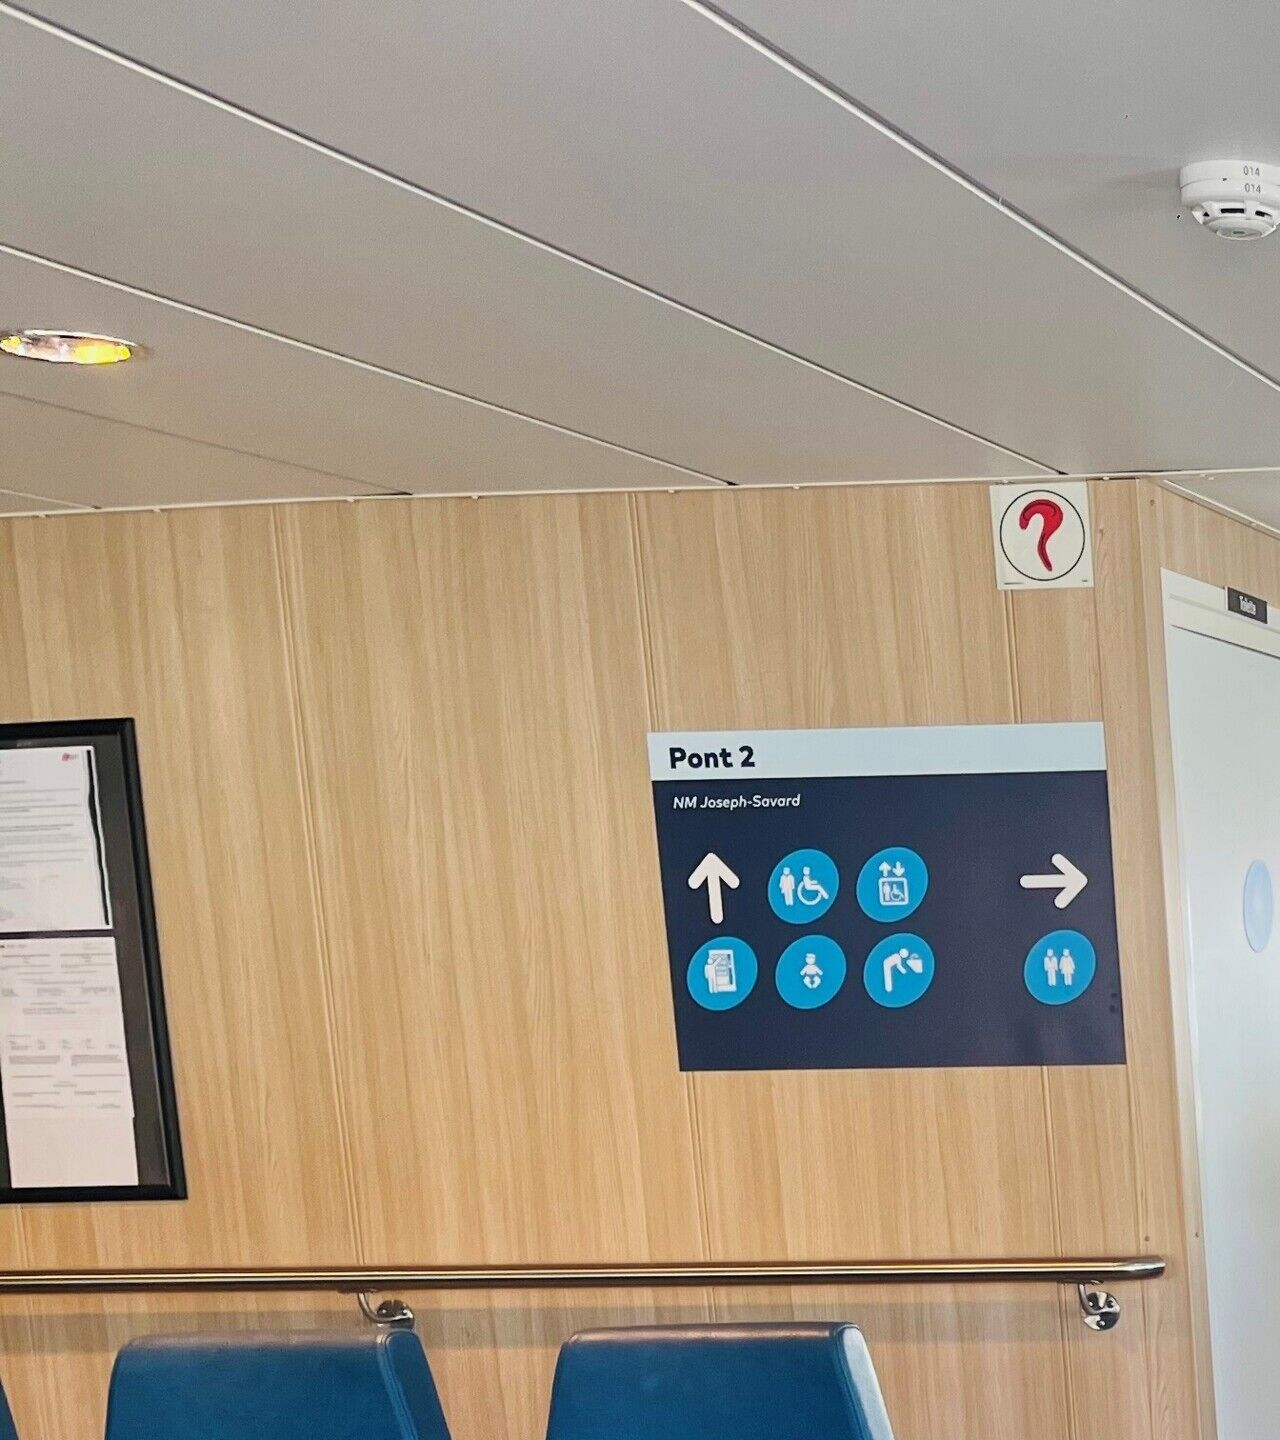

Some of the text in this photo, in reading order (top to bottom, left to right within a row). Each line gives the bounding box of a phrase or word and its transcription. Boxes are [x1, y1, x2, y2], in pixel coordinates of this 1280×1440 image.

[1243, 165, 1260, 176] 014
[1244, 182, 1261, 194] 014
[669, 745, 755, 769] Pont 2
[673, 793, 800, 811] NM Joseph-Savard
